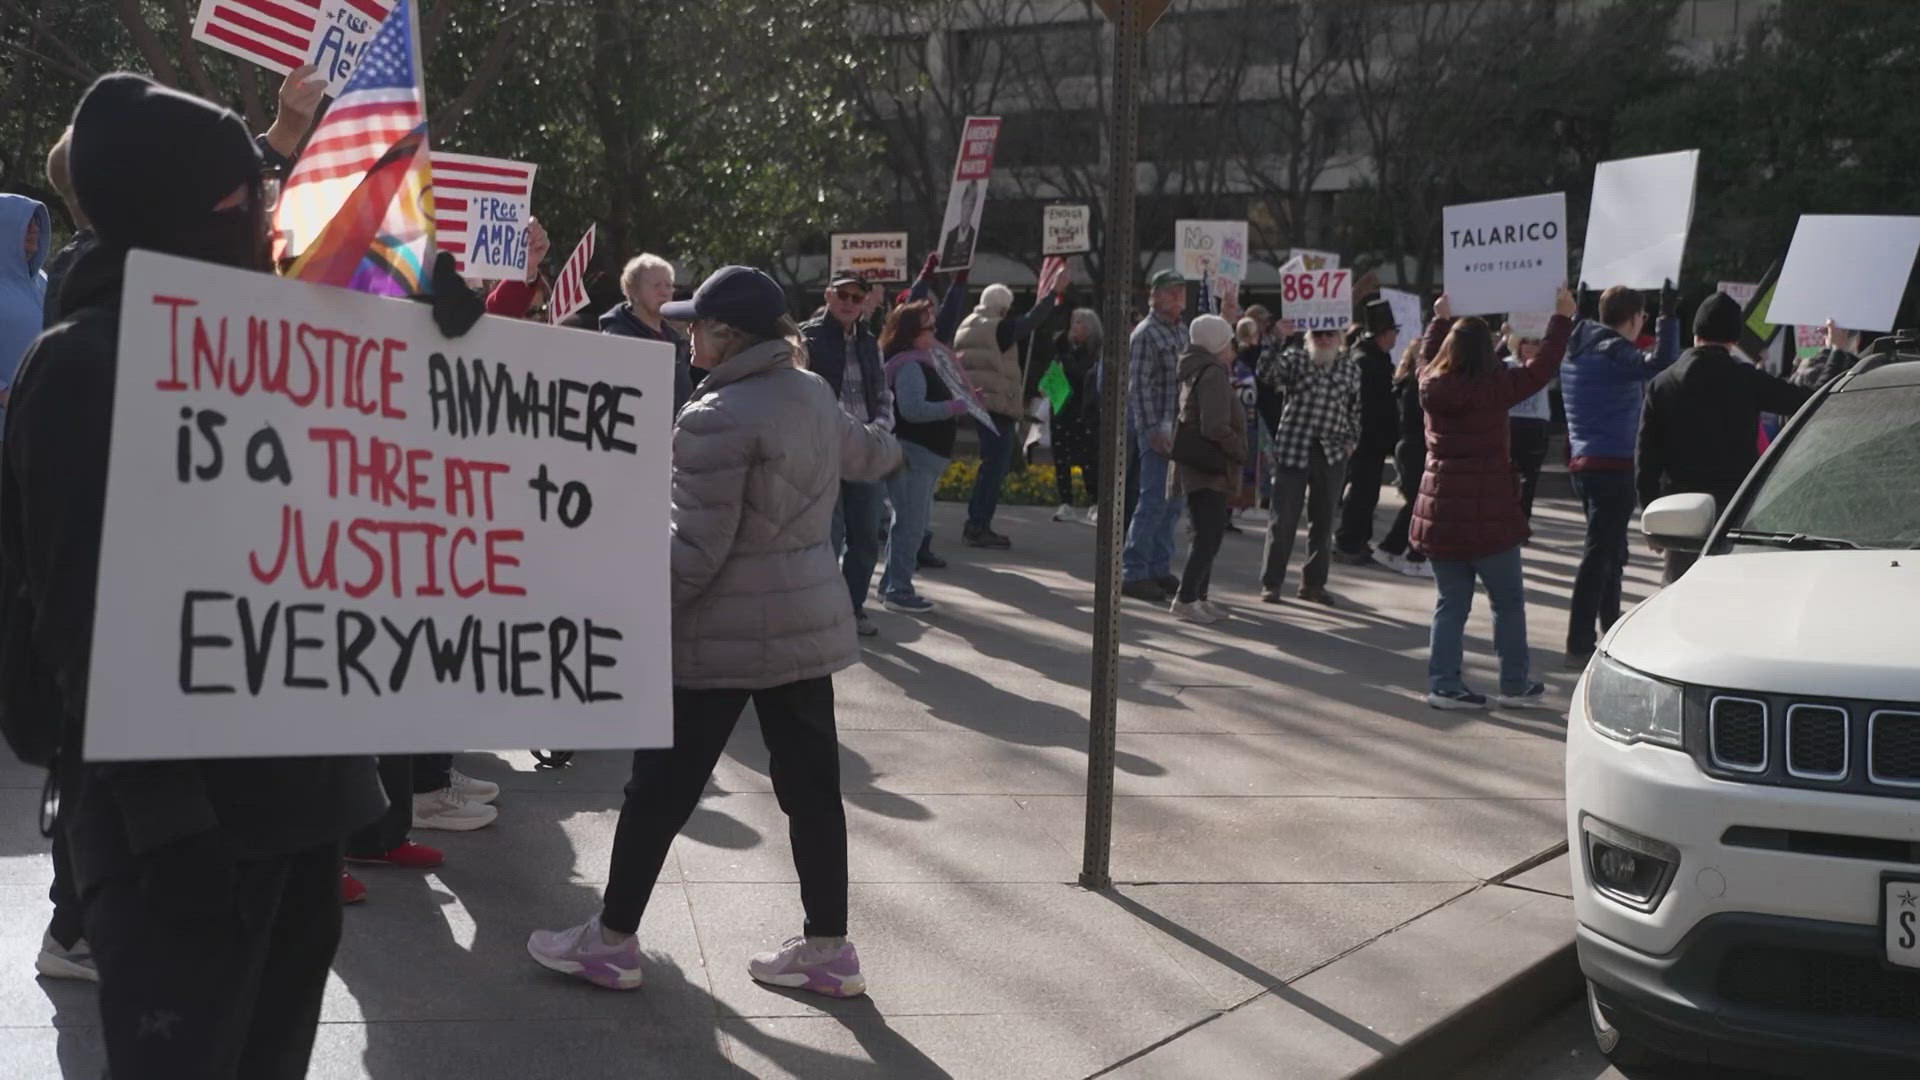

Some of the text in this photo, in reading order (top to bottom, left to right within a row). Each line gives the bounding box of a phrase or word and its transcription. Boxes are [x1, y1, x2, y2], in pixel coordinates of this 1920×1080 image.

[1450, 221, 1558, 249] TALARICO
[1473, 259, 1533, 272] FOR TEXAS
[153, 295, 642, 454] INJUSTICE ANYWHERE
[244, 426, 292, 485] a
[308, 428, 510, 521] THREAT
[529, 464, 592, 528] to
[248, 504, 526, 599] JUSTICE
[178, 590, 623, 704] EVERYWHERE
